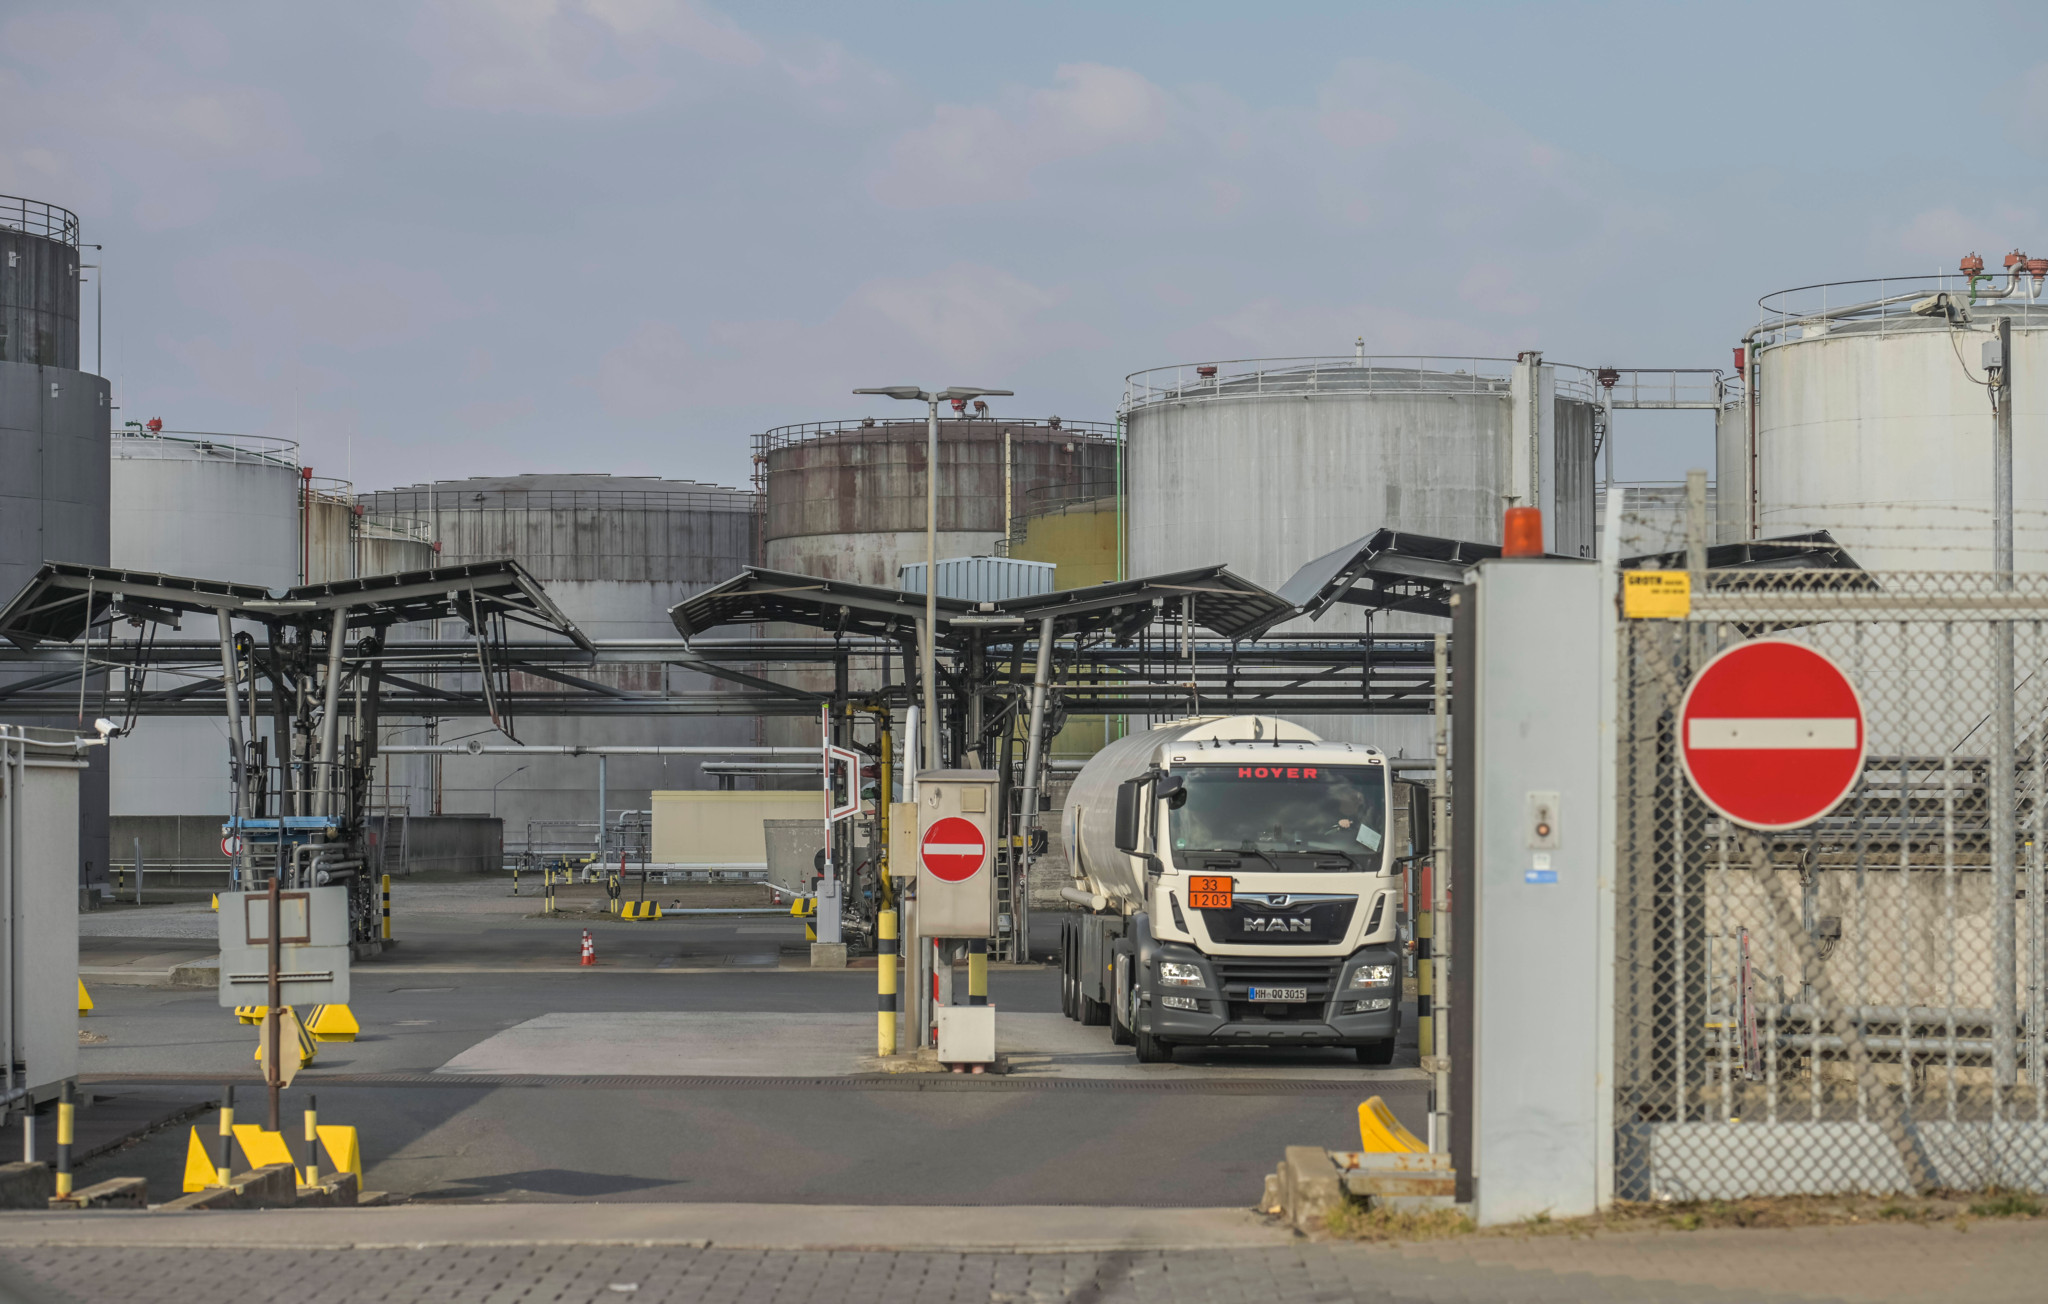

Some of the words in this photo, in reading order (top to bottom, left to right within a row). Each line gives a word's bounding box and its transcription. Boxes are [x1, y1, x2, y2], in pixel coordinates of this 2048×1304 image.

[1238, 767, 1318, 779] HOYER
[1202, 879, 1218, 891] 33
[1194, 894, 1228, 906] 1203
[1243, 917, 1312, 932] MAN
[1255, 989, 1266, 999] HH
[1284, 989, 1305, 999] 3015
